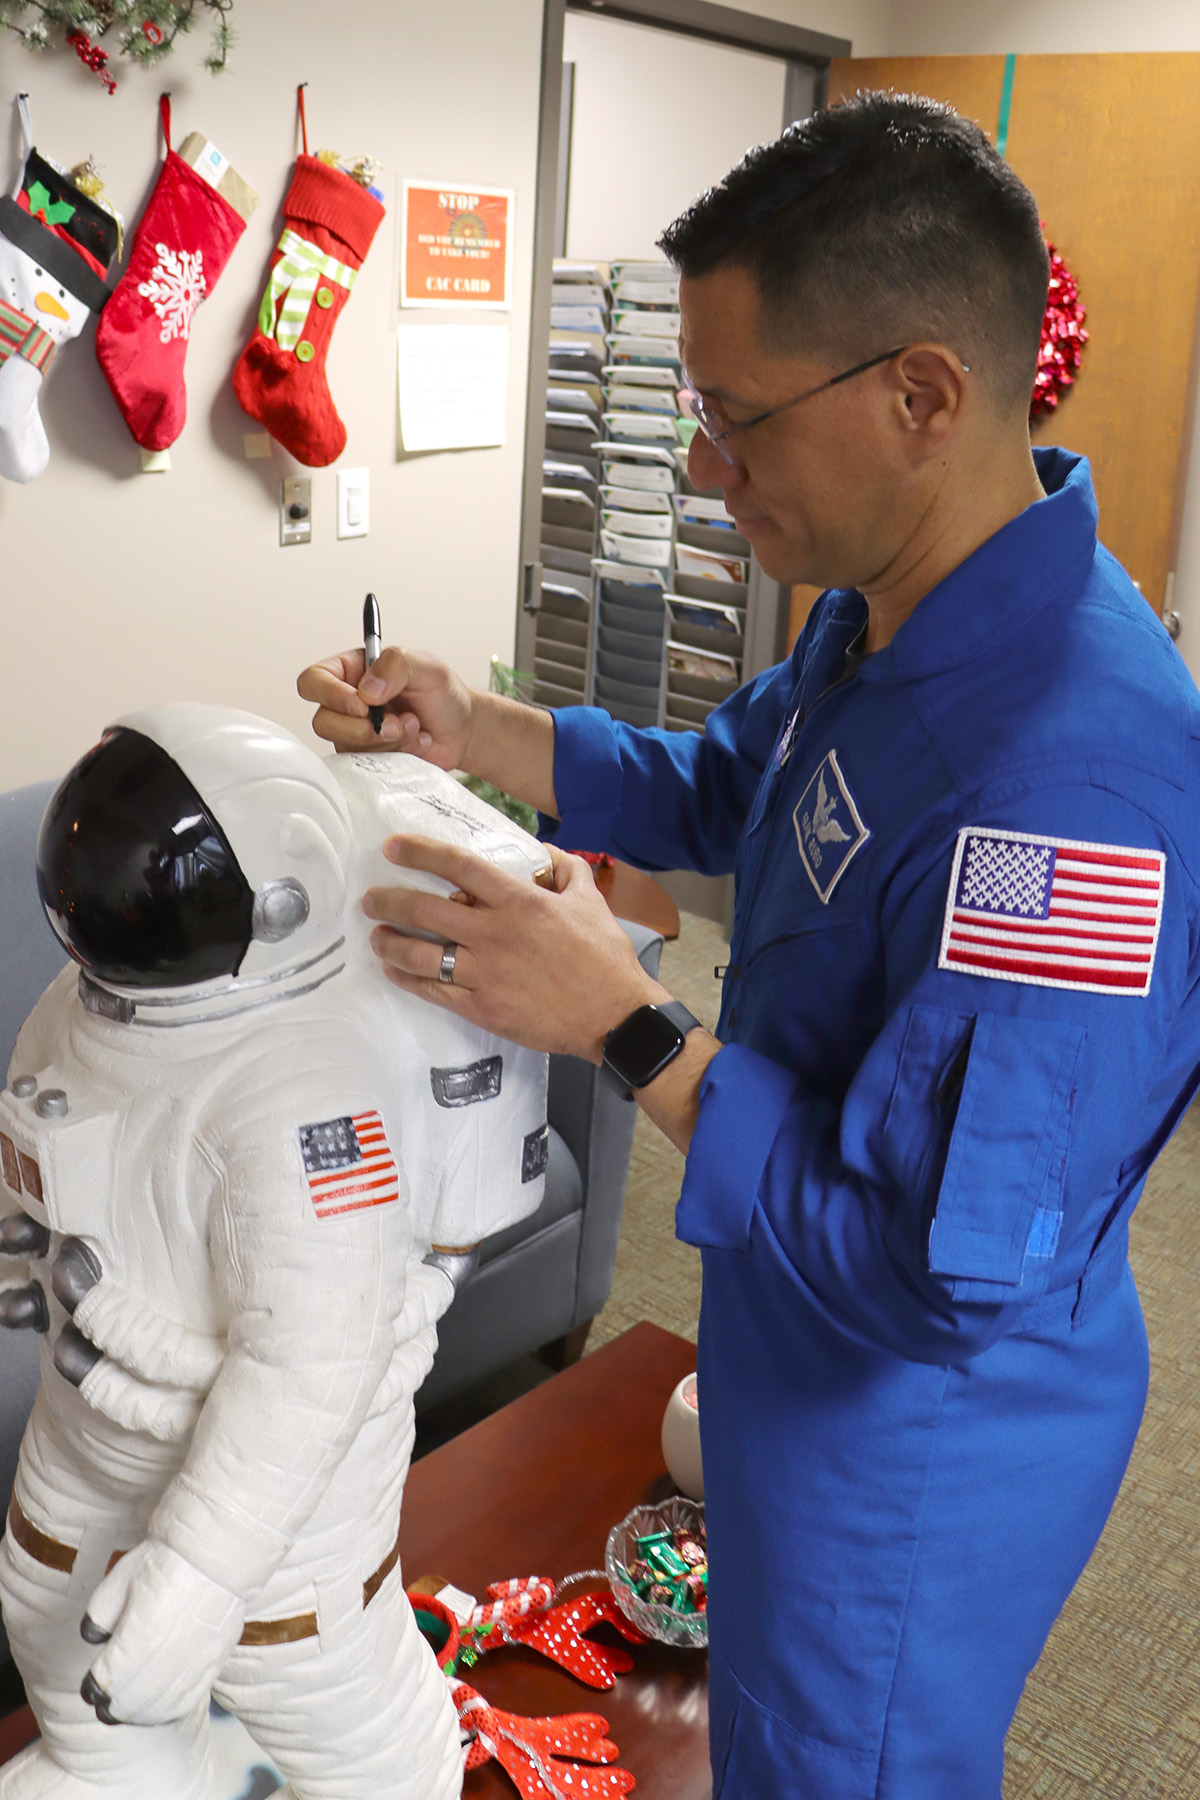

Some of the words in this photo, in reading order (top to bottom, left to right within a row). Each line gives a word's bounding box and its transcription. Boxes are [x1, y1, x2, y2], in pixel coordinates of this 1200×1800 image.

[438, 193, 479, 211] STOP
[429, 246, 441, 256] TO
[426, 276, 452, 292] CAC
[453, 277, 490, 293] CARD
